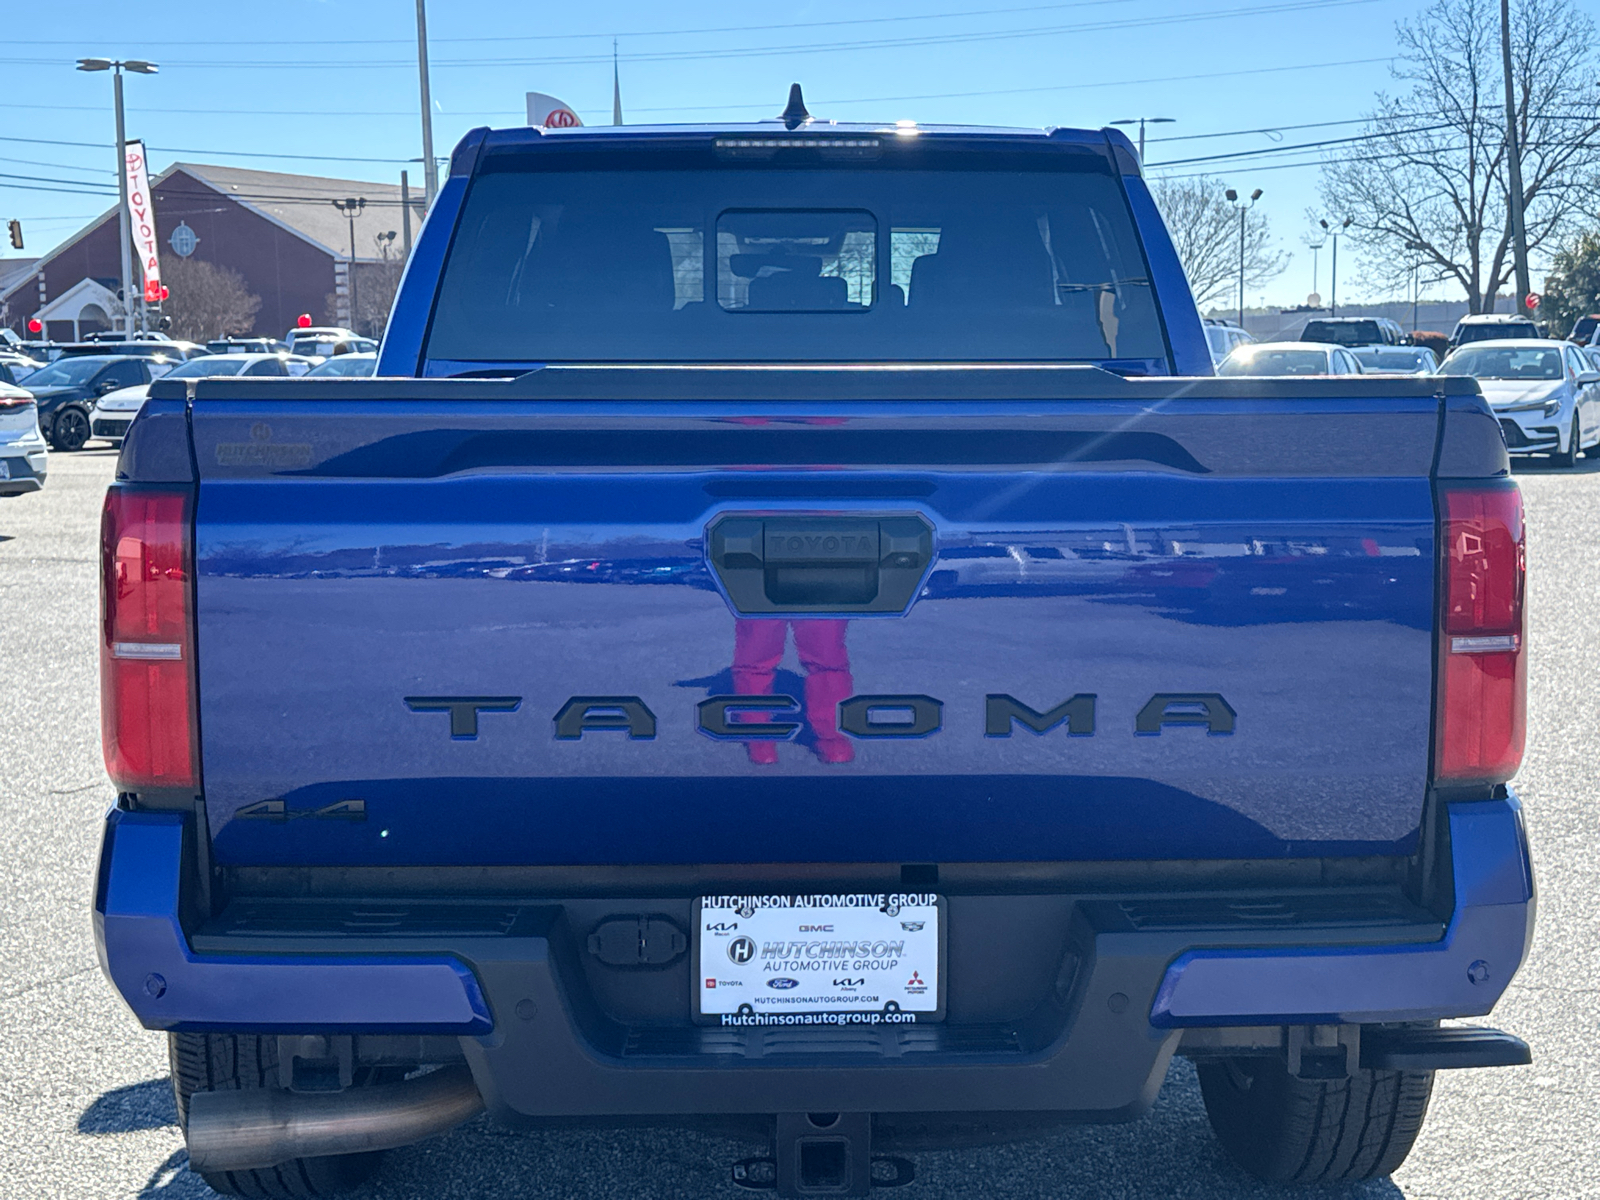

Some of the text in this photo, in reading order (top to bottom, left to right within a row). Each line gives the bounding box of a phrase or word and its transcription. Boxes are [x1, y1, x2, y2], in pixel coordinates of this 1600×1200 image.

[130, 174, 158, 270] TOYOTA
[770, 535, 873, 553] TOYOTA
[402, 693, 1238, 742] TACOMA
[701, 893, 937, 908] HUTCHINSON AUTOMOTIVE GROUP
[706, 922, 738, 931] KIA
[760, 940, 905, 959] HUTCHINSON
[763, 960, 898, 971] AUTOMOTIVE GROUP
[833, 978, 865, 986] KIA
[754, 996, 879, 1004] HUTCHINSONAUTOGROUP.COM
[721, 1012, 916, 1026] Hutchinsonautogroup.com
